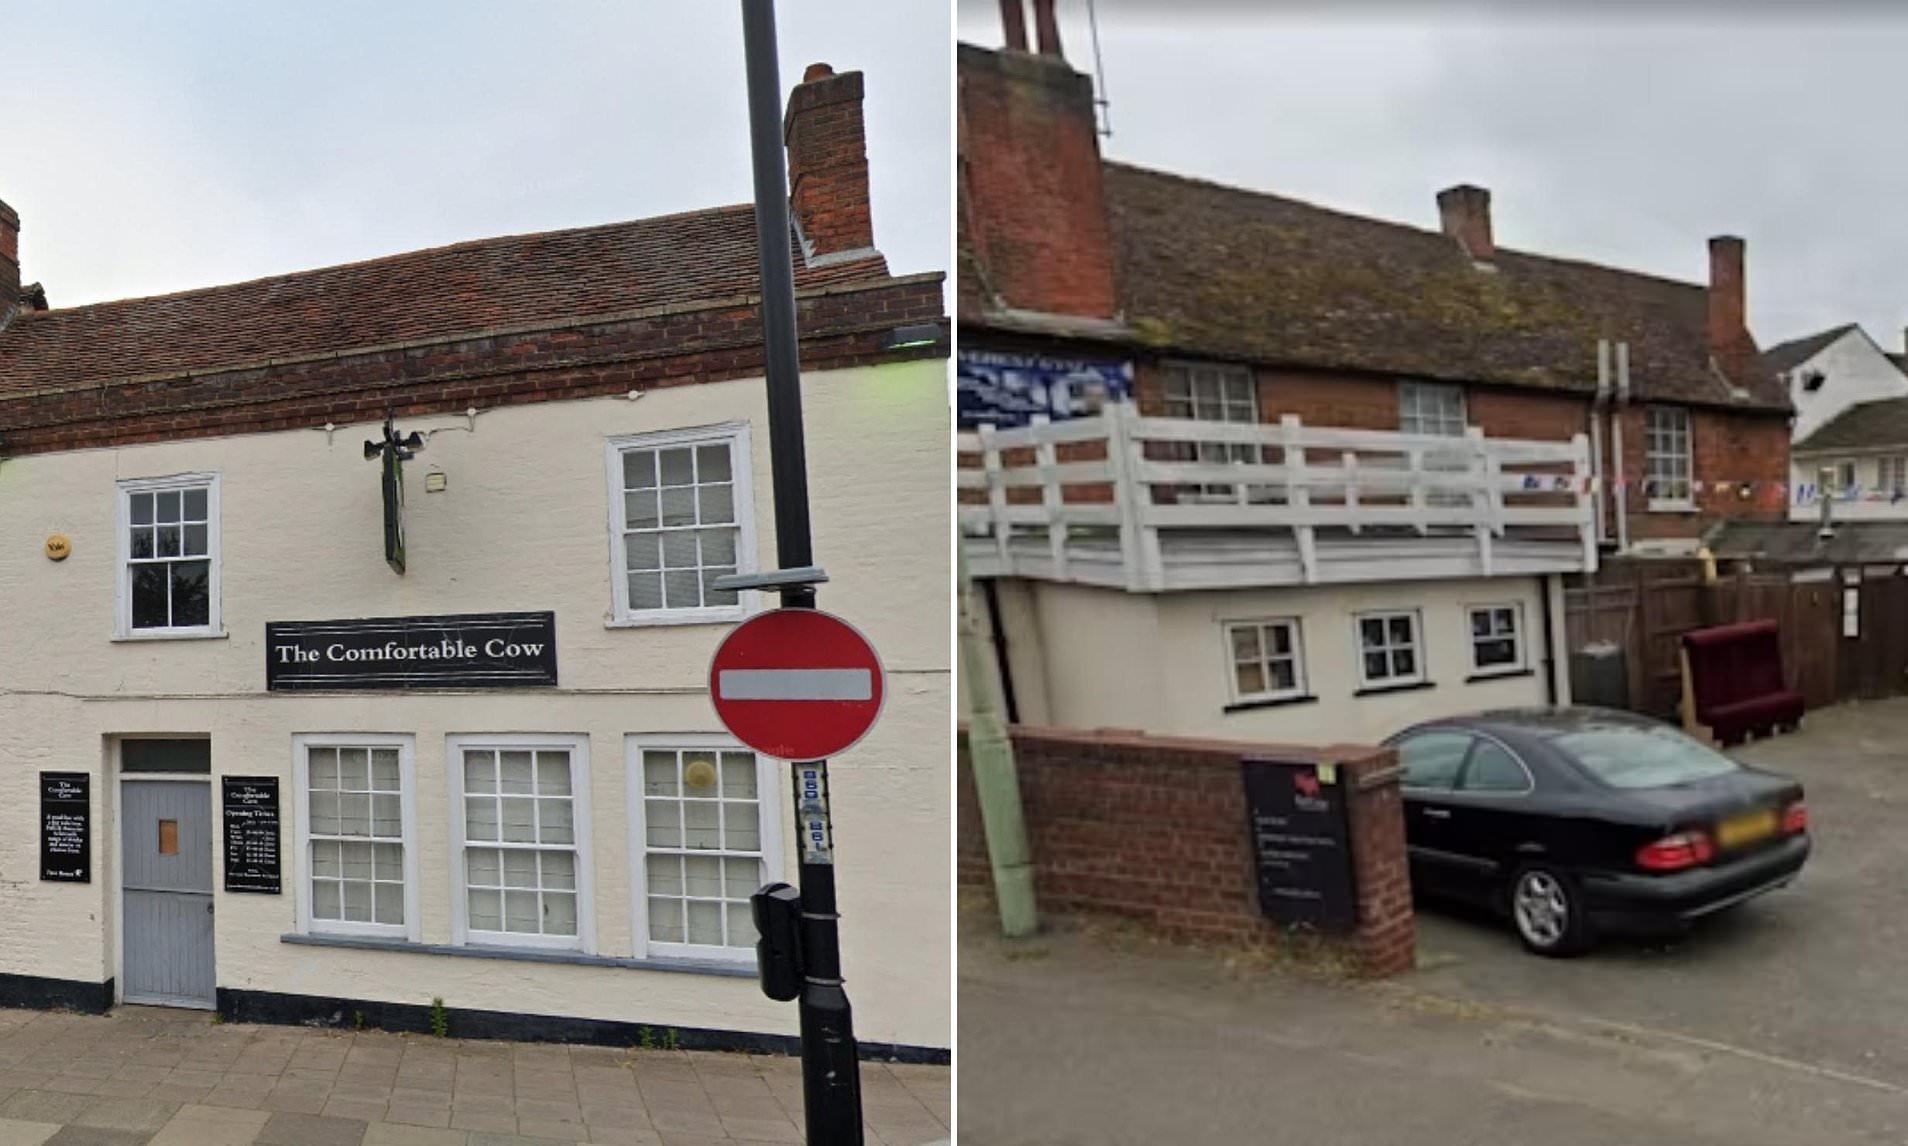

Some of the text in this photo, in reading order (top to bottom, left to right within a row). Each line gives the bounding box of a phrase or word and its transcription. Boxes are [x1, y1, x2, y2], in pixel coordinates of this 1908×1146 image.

[274, 638, 544, 663] The Comfortable Cow
